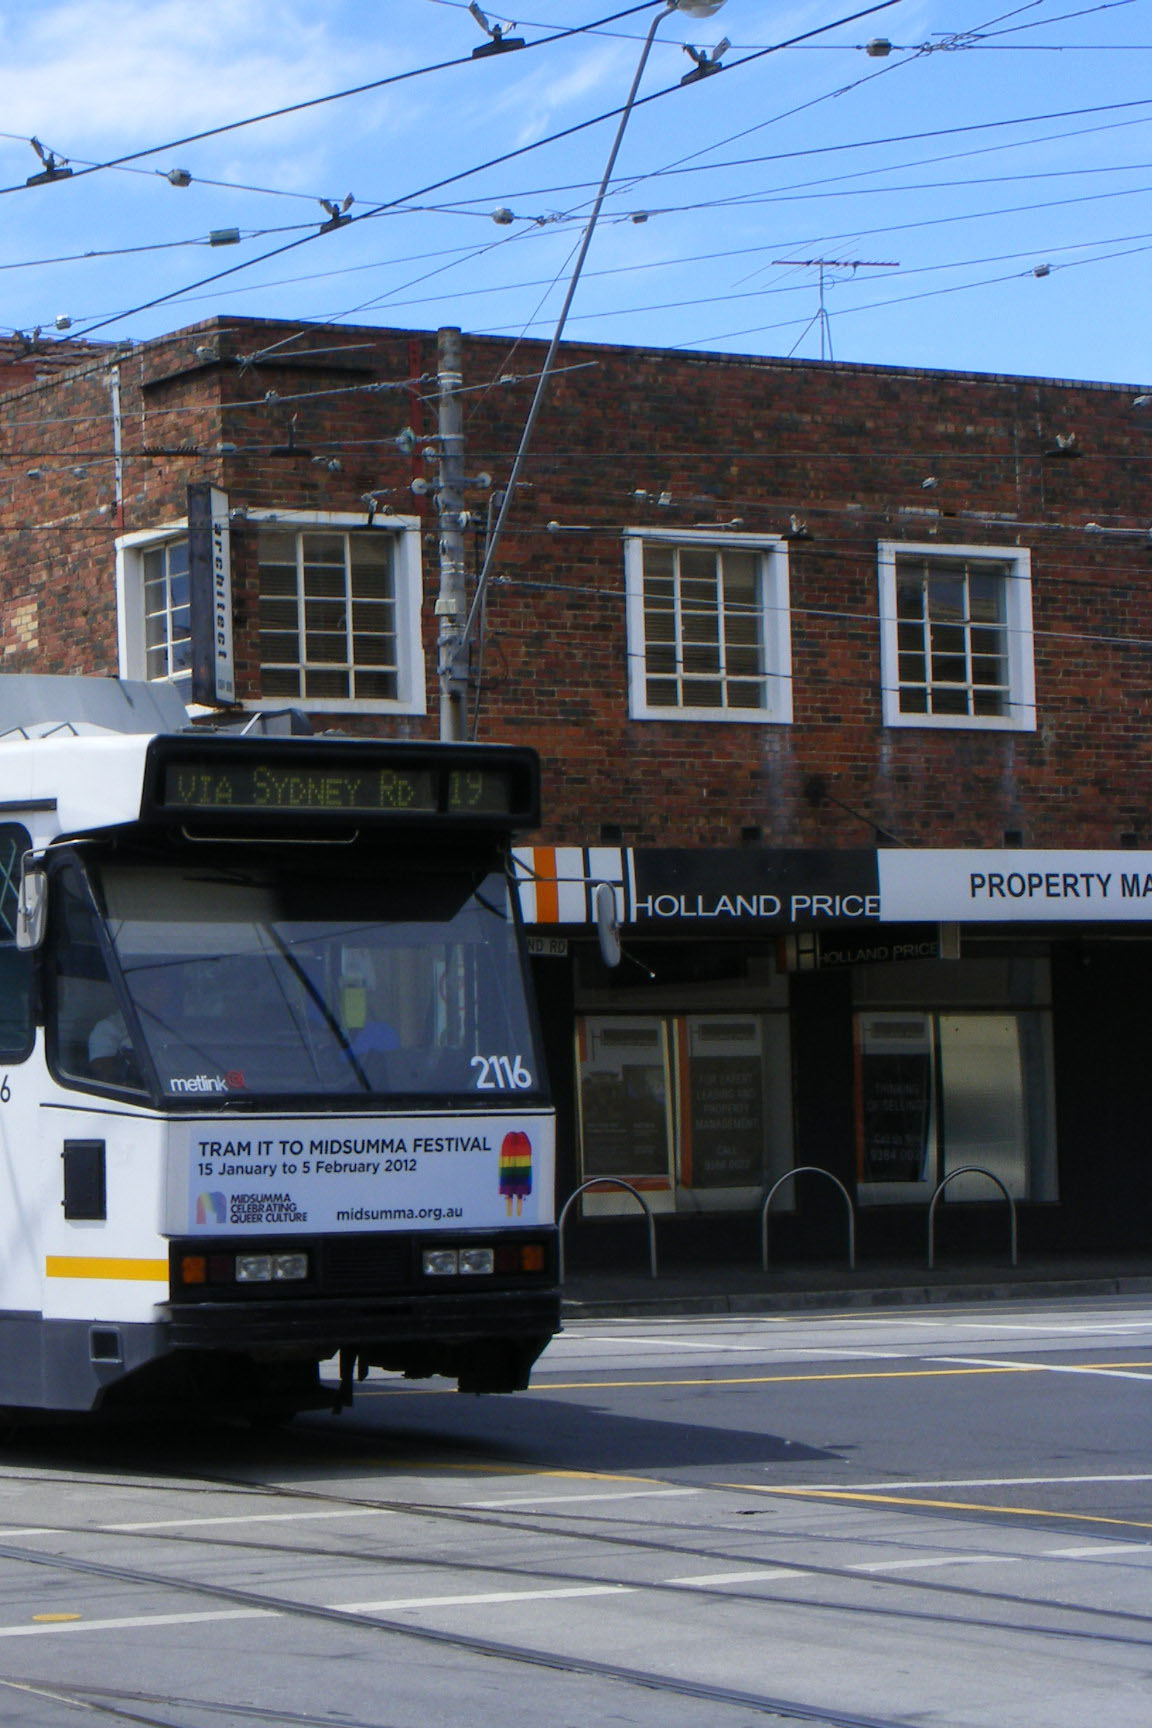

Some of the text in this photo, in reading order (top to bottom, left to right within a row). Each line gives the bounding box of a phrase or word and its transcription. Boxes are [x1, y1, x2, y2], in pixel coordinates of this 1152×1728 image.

[214, 522, 227, 659] architect
[178, 775, 232, 803] VIA
[450, 771, 483, 804] 19
[970, 873, 1112, 898] PROPERTY
[630, 895, 880, 922] HOLLAND PRICE
[550, 939, 566, 953] RD
[892, 942, 937, 961] PRICE
[470, 1055, 533, 1089] 2116
[170, 1074, 228, 1092] metlink
[198, 1136, 492, 1157] TRAM IT TO MIDSUMMA FESTIVAL
[198, 1159, 418, 1177] 15 January to 5 February 2012
[230, 1193, 291, 1204] MIDSUMMA
[230, 1202, 297, 1214] CELEBRATING
[336, 1206, 463, 1221] midsumma.org.au
[230, 1211, 308, 1224] QUEER CULTURE
